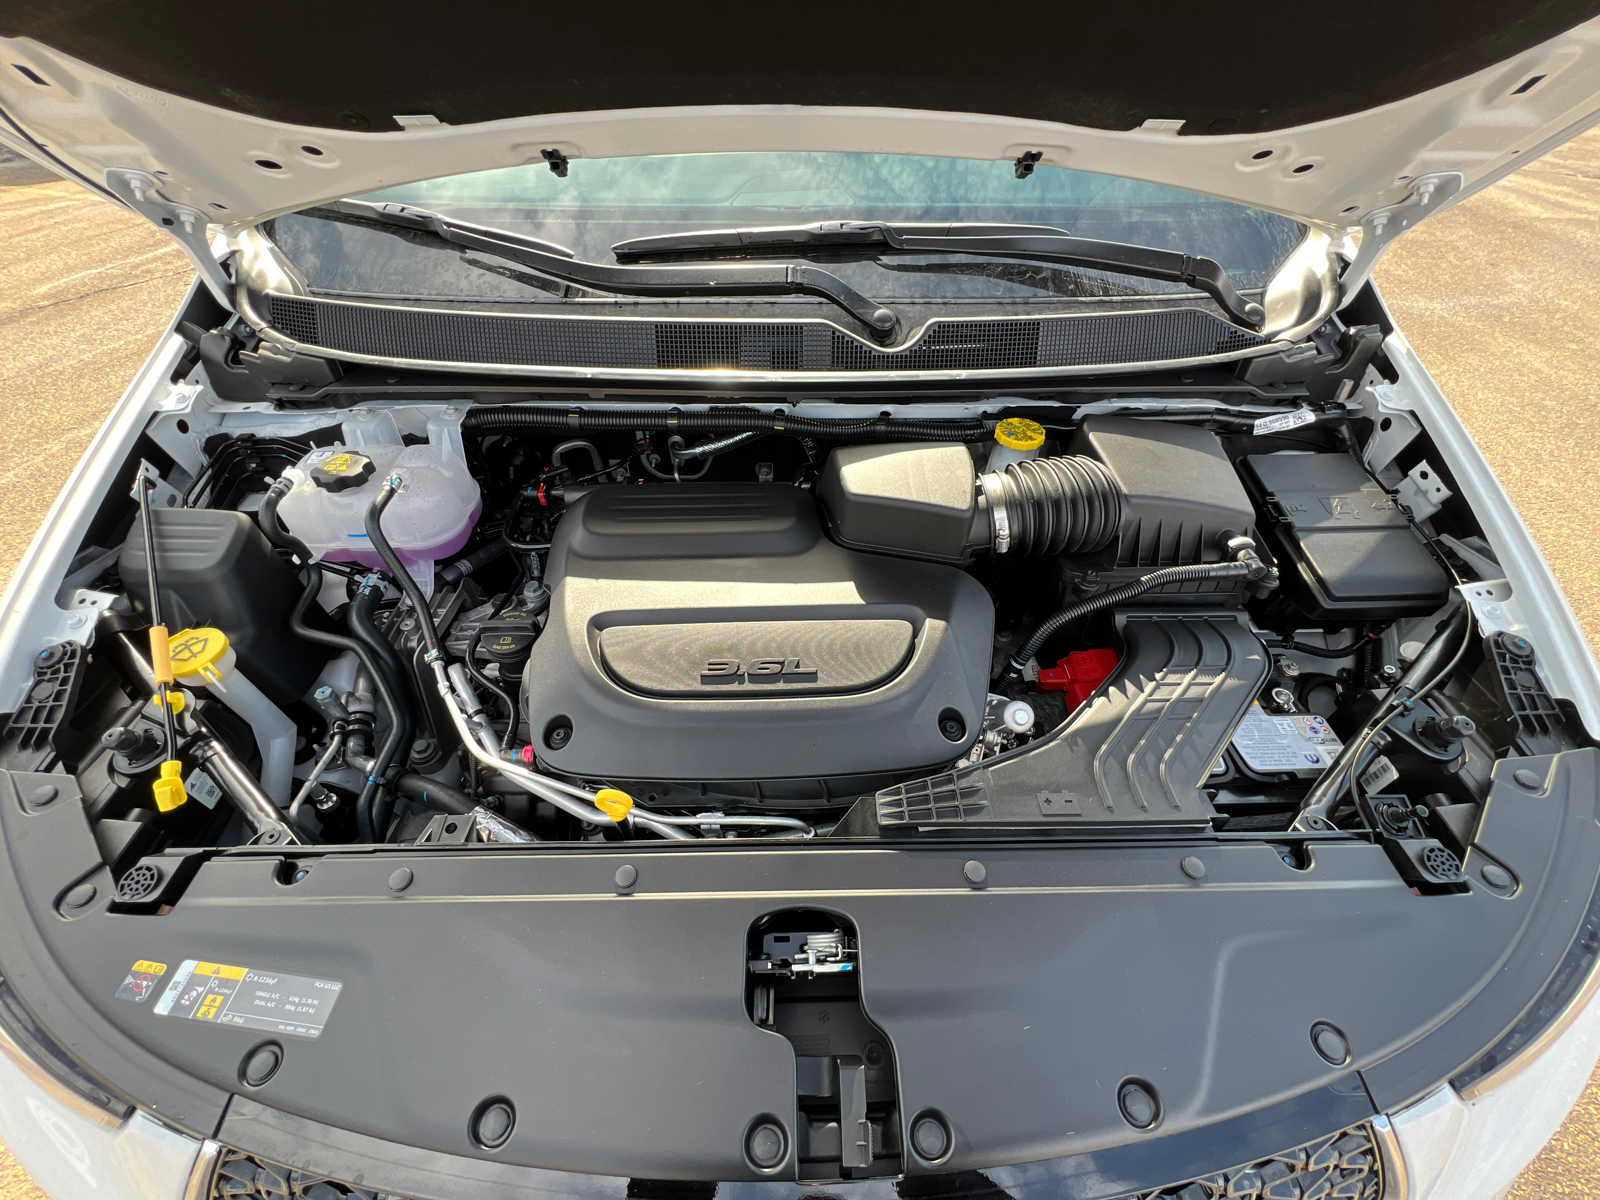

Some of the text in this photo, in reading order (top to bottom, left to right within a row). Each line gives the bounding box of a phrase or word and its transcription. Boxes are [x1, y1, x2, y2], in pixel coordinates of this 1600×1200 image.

[700, 657, 818, 683] 3.6L
[252, 975, 278, 985] R-1234yf
[255, 990, 271, 998] SINGLE
[232, 1015, 244, 1024] PAG
